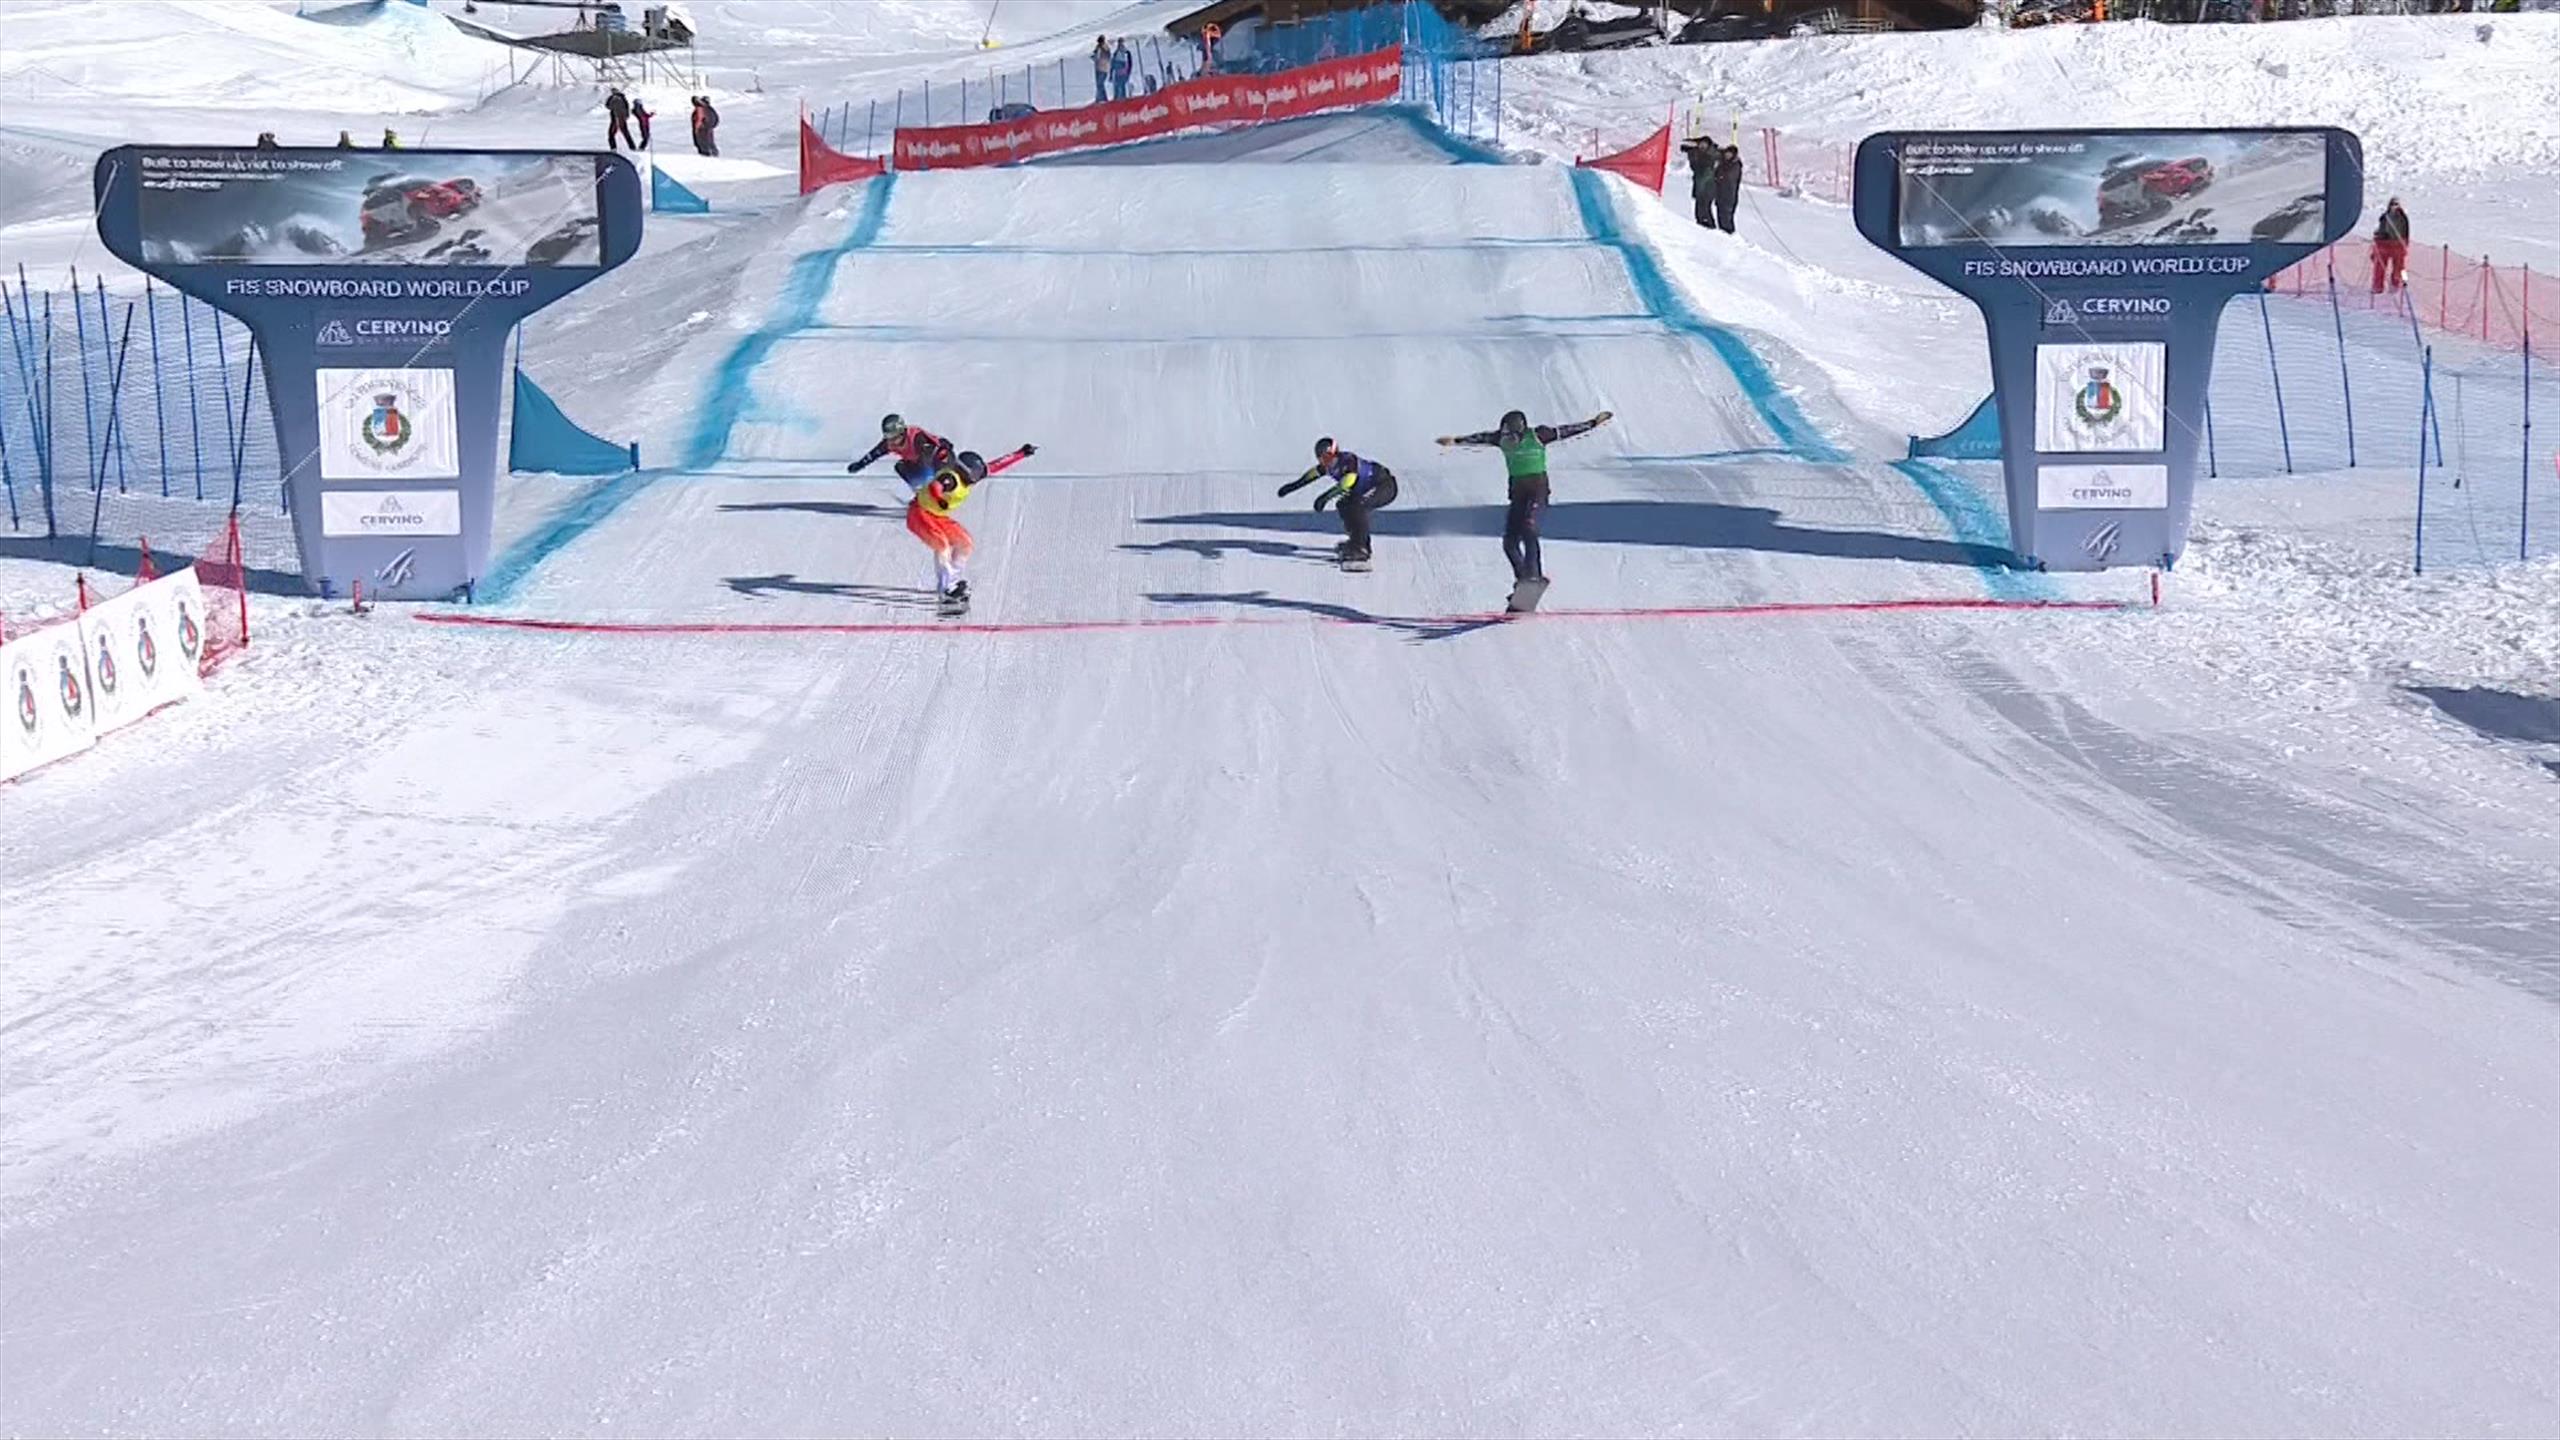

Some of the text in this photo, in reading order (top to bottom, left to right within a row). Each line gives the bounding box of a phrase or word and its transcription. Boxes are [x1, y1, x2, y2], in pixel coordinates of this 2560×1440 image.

[1964, 257, 2251, 277] FIS SNOWBOARD WORLD CUP
[226, 279, 531, 298] FIS SNOWBOARD WORLD CUP
[2083, 298, 2171, 313] CERVINO
[356, 320, 451, 335] CERVINO
[2072, 488, 2132, 499] CERVINO
[360, 515, 423, 525] CERVINO
